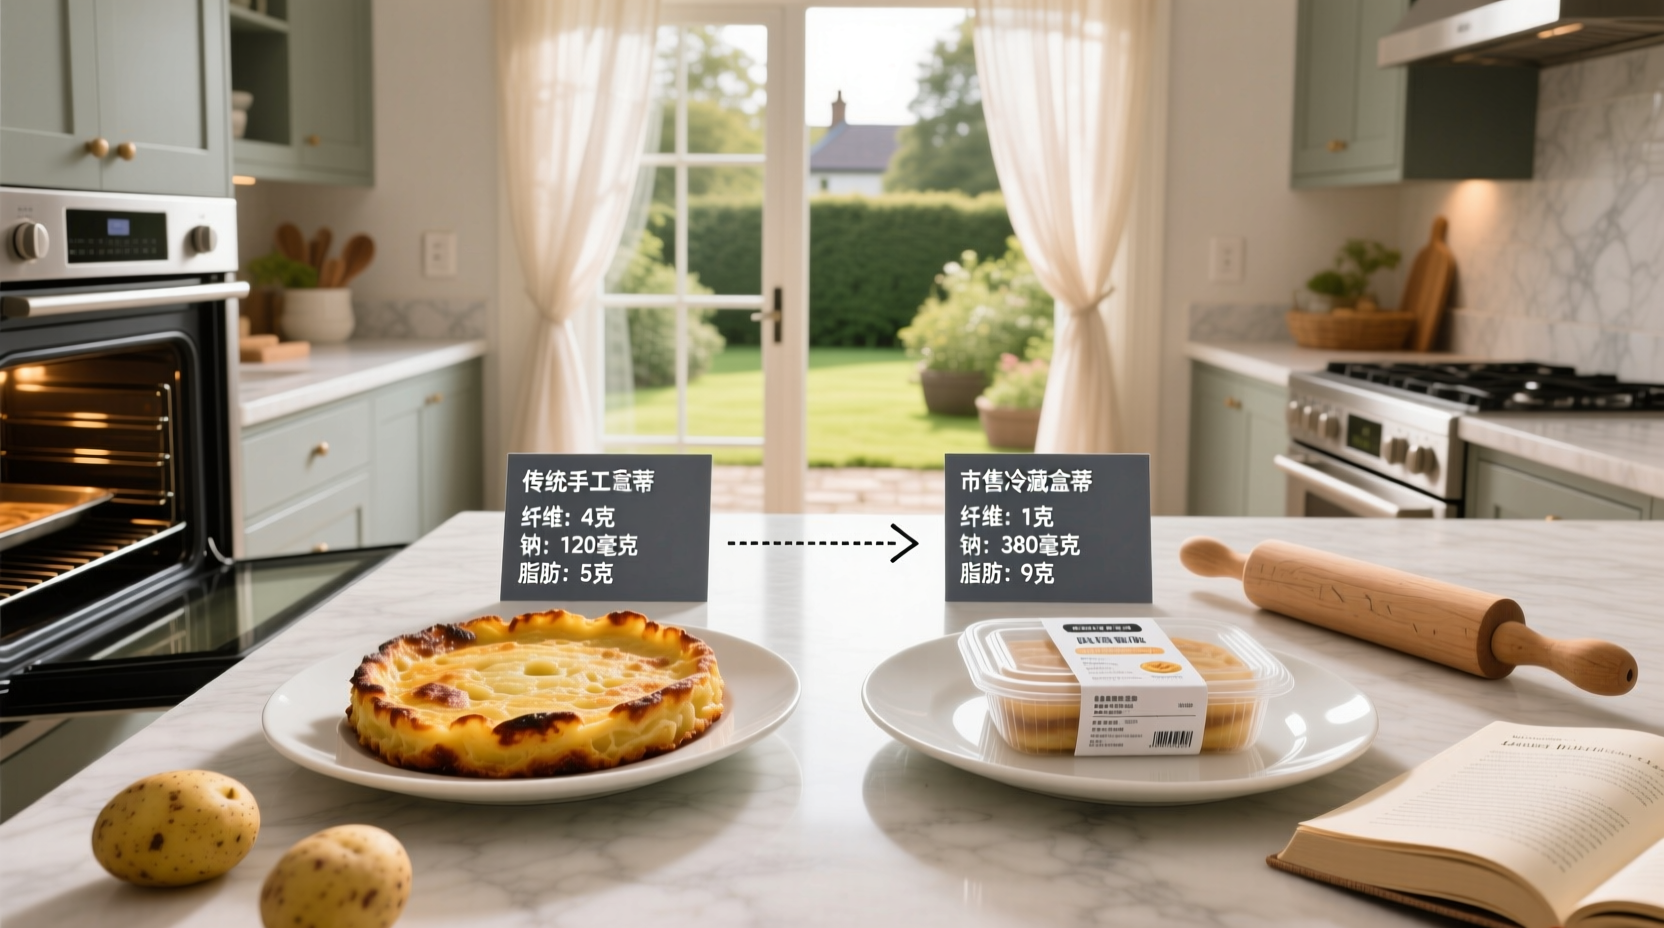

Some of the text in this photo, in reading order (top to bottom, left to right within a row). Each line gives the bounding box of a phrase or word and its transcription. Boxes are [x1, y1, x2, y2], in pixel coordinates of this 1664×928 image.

[960, 468, 1093, 493] 市售冷藏盒蒂
[520, 504, 616, 528] 纤维：4克
[960, 503, 1054, 528] 纤维：1克
[519, 532, 638, 557] 钠：120毫克
[960, 532, 1081, 557] 钠：380毫克
[517, 560, 614, 585] 脂肪：5克
[960, 560, 1055, 585] 脂肪：9克
